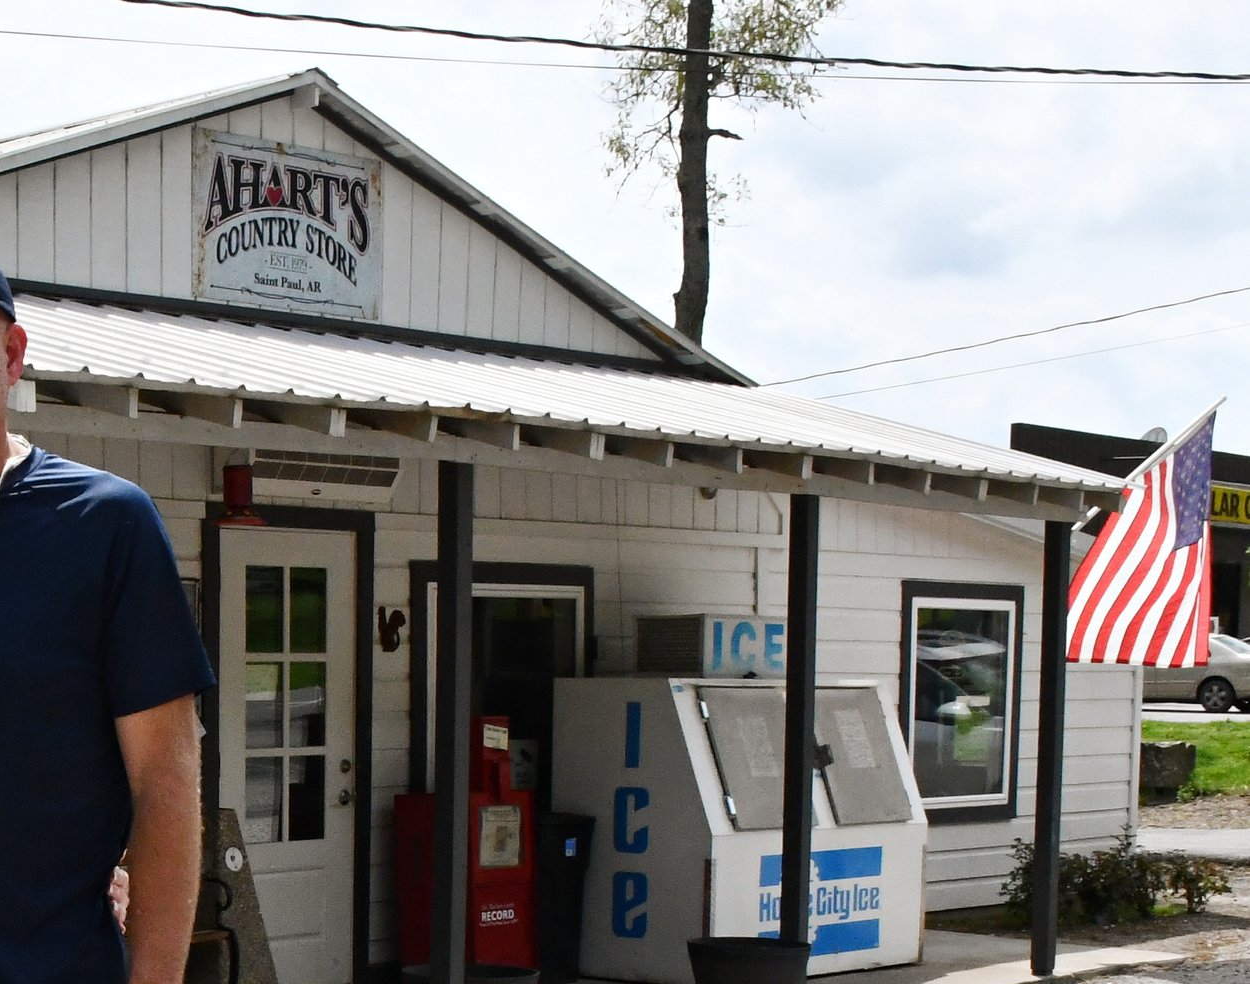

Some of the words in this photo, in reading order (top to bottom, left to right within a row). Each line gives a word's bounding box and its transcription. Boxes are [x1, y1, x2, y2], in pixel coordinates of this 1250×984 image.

[203, 152, 370, 256] AHART'S
[216, 217, 300, 264] COUNTRY
[305, 224, 358, 287] STORE
[254, 272, 278, 287] Saint
[281, 276, 305, 293] Paul,
[307, 281, 322, 293] AR
[710, 621, 784, 671] ICE
[481, 909, 515, 922] RECORD
[816, 885, 850, 920] City
[853, 883, 880, 911] Ice
